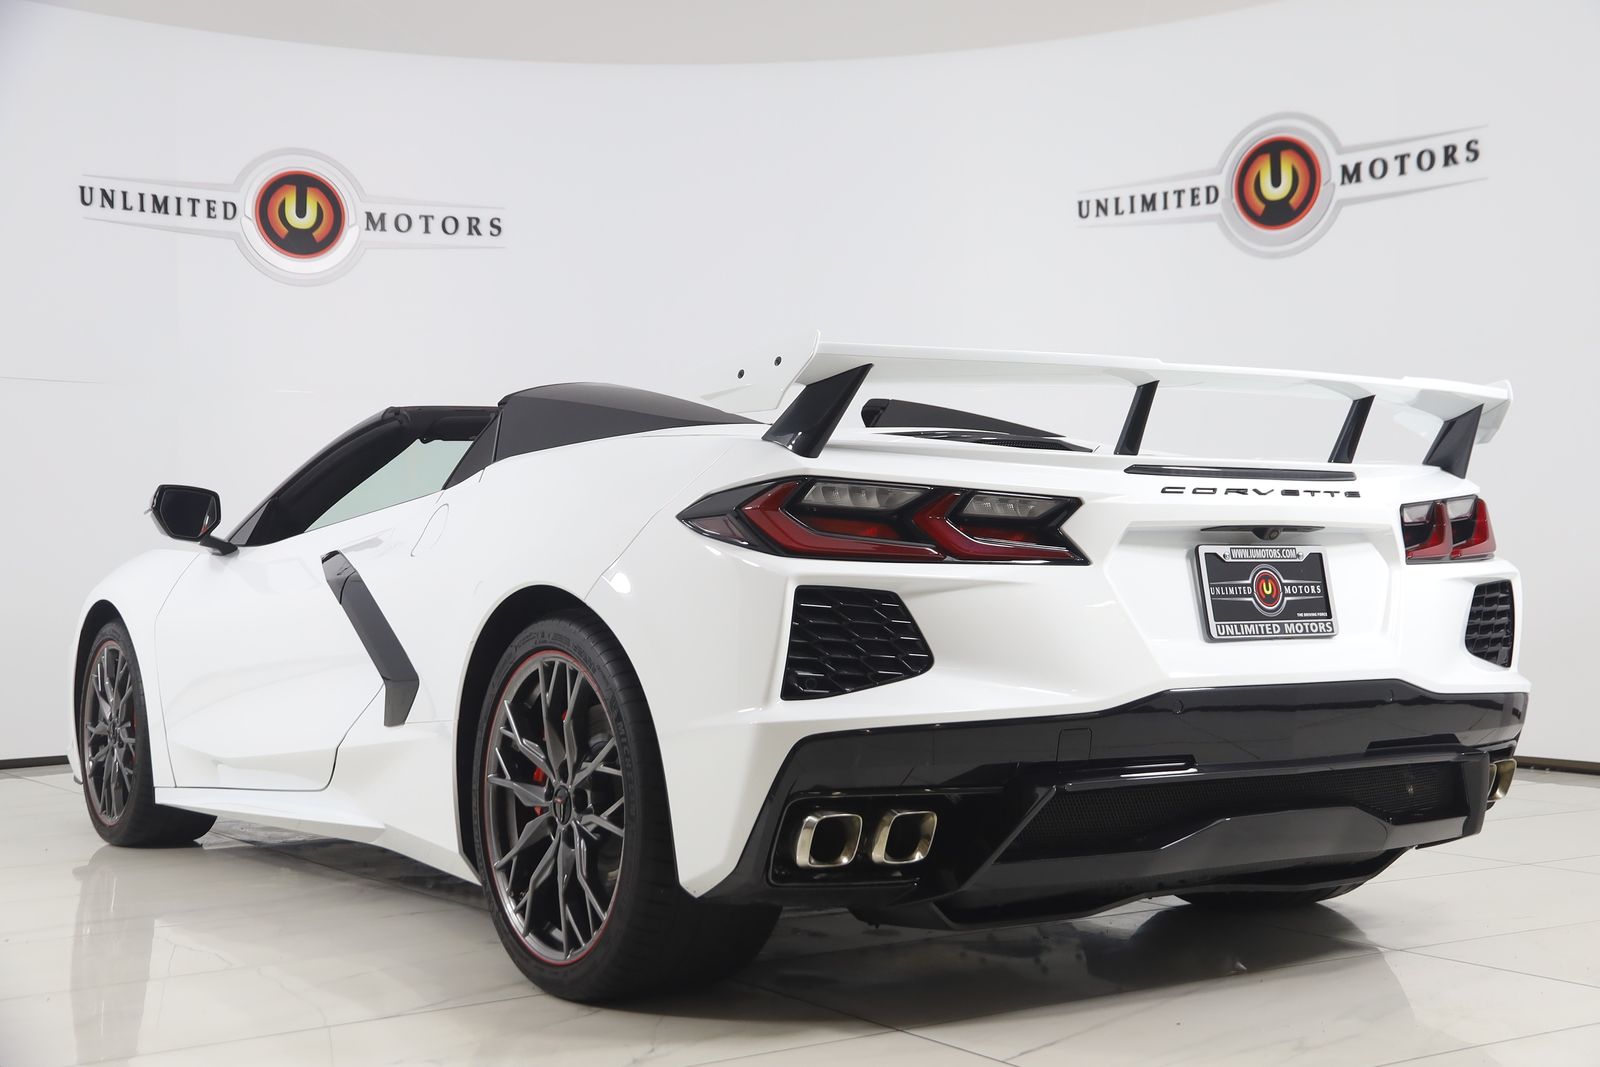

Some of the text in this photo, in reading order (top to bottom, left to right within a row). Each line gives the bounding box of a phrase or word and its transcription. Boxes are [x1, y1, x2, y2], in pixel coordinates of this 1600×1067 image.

[1077, 184, 1221, 220] UNLIMITED
[1339, 138, 1481, 187] MOTORS
[78, 185, 238, 221] UNLIMITED
[364, 211, 502, 237] MOTORS
[1160, 486, 1361, 498] CORVETTE
[1231, 548, 1296, 559] WWW.IUMOTORS.COM
[1210, 586, 1252, 595] UNLIMITED
[1284, 585, 1322, 594] MOTORS
[1217, 622, 1333, 636] UNLIMITED MOTORS
